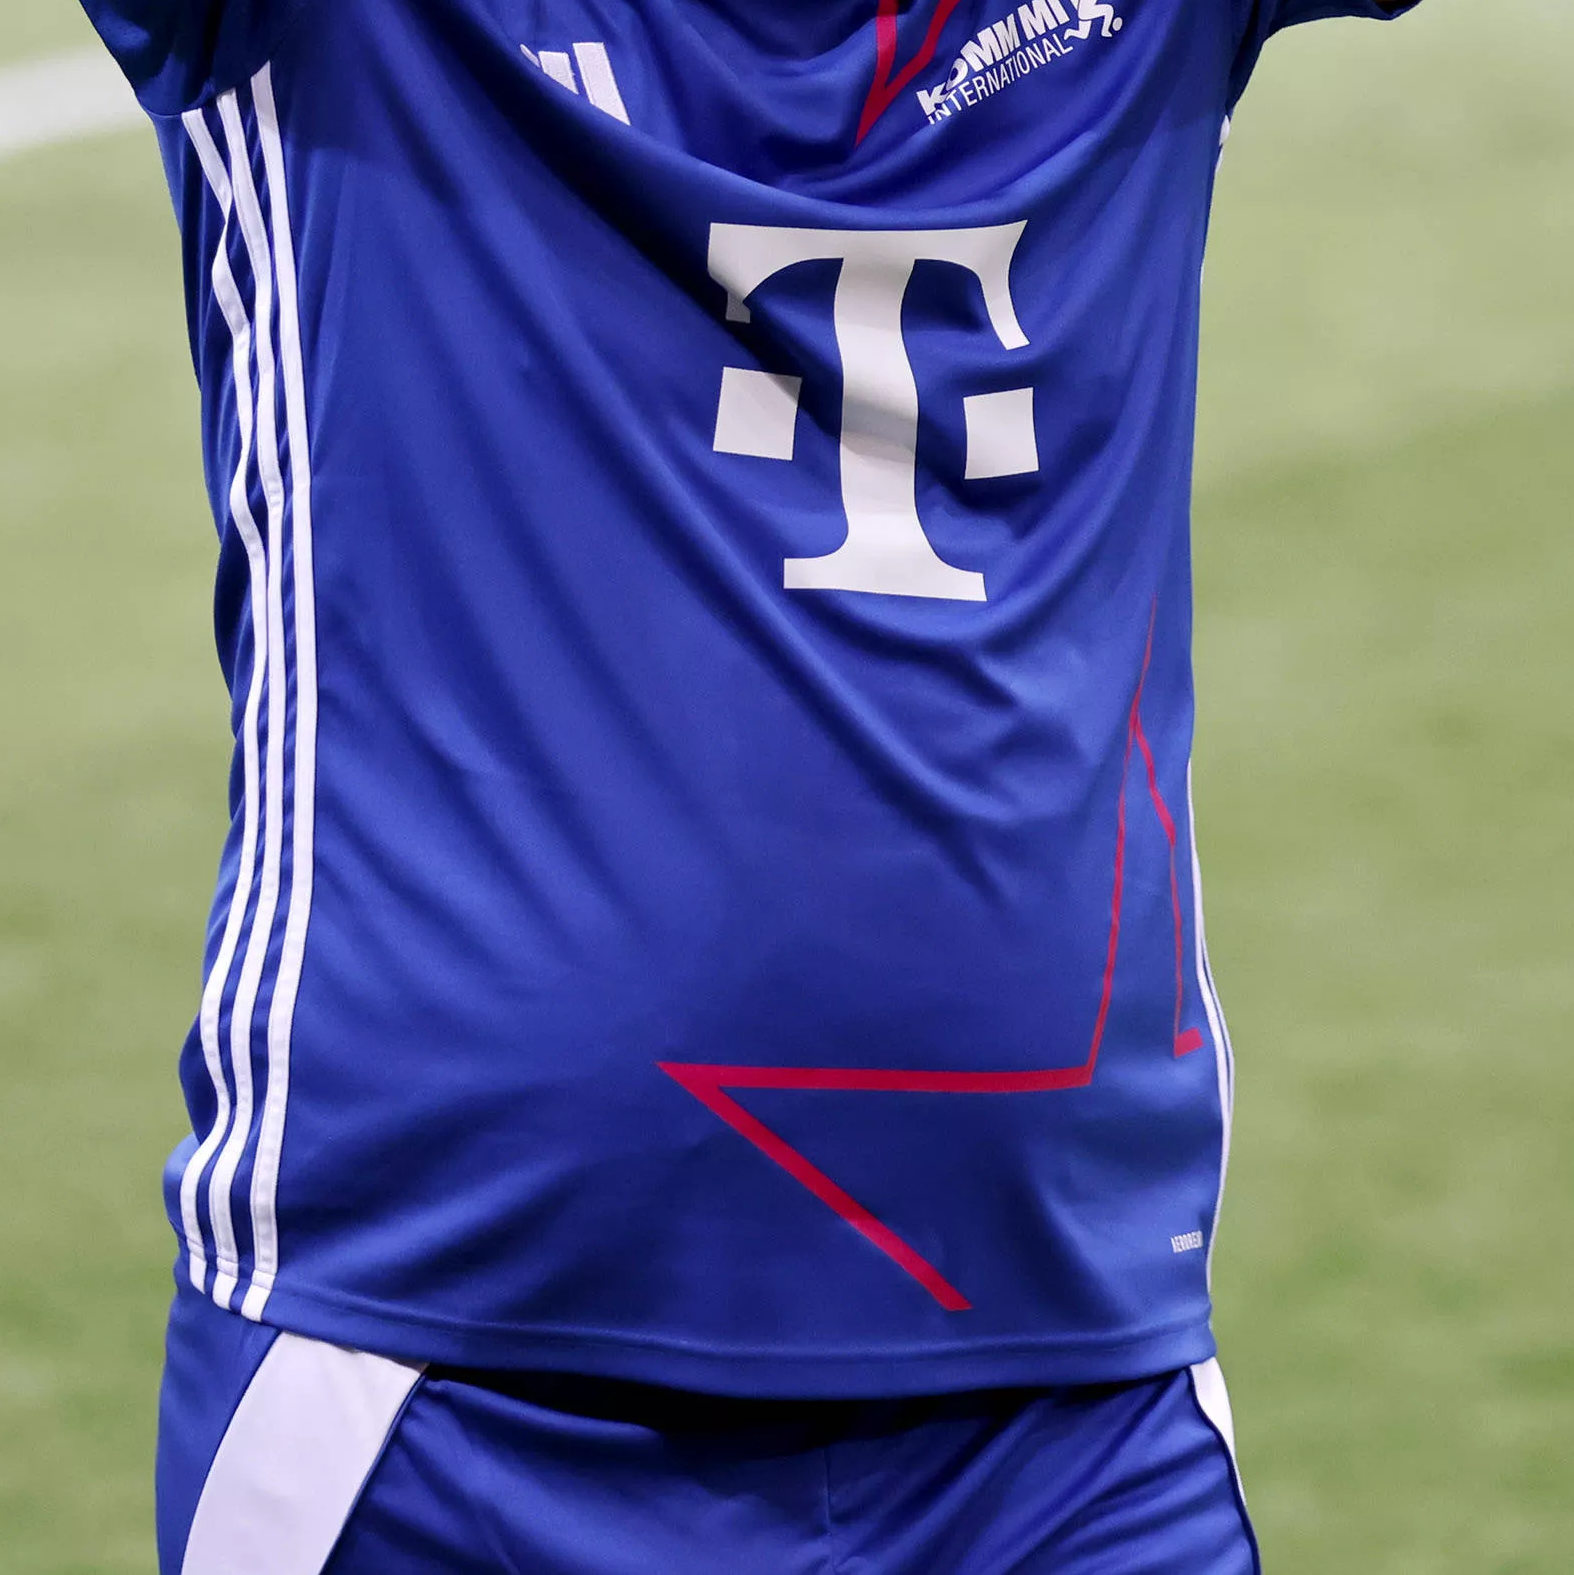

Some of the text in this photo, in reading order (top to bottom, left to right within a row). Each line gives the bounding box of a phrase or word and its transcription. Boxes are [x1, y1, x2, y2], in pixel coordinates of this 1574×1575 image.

[916, 14, 1022, 115] KOMM
[927, 33, 1074, 124] INTERNATIONAL
[707, 219, 1039, 601] T
